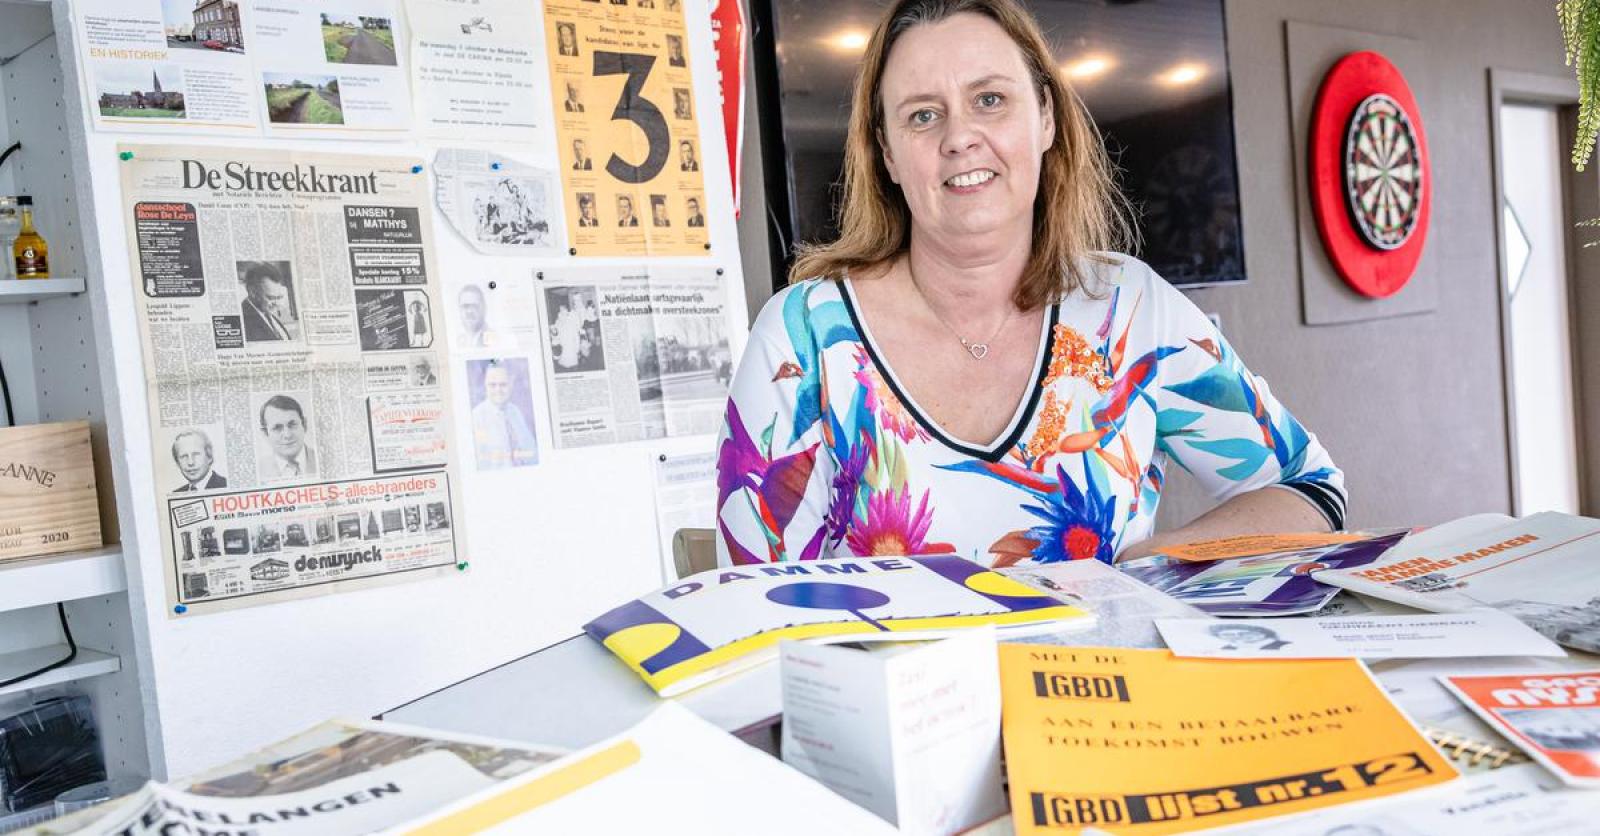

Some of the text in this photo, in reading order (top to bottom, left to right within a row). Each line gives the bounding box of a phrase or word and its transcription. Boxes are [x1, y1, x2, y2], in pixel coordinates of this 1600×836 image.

[89, 48, 168, 61] EN HISTORIEK
[592, 50, 672, 184] 3
[181, 159, 379, 195] De Streekkrant
[137, 211, 160, 219] Rose
[160, 211, 173, 219] De
[347, 207, 396, 218] DANSEN ?
[363, 218, 408, 229] MATTHYS
[212, 477, 437, 513] HOUTKACHELS-allesbranders
[41, 531, 70, 545] 2020
[1454, 533, 1540, 563] MAKEN
[662, 558, 914, 600] DAMME
[1029, 652, 1127, 665] MET DE
[1048, 673, 1116, 699] GBD
[1043, 704, 1362, 730] AAN EEN BETAALBARE
[1042, 722, 1344, 749] TOEKOMST BOUWEN
[1050, 794, 1123, 826] GBD
[1254, 774, 1323, 806] nr.
[1322, 752, 1433, 793] 12
